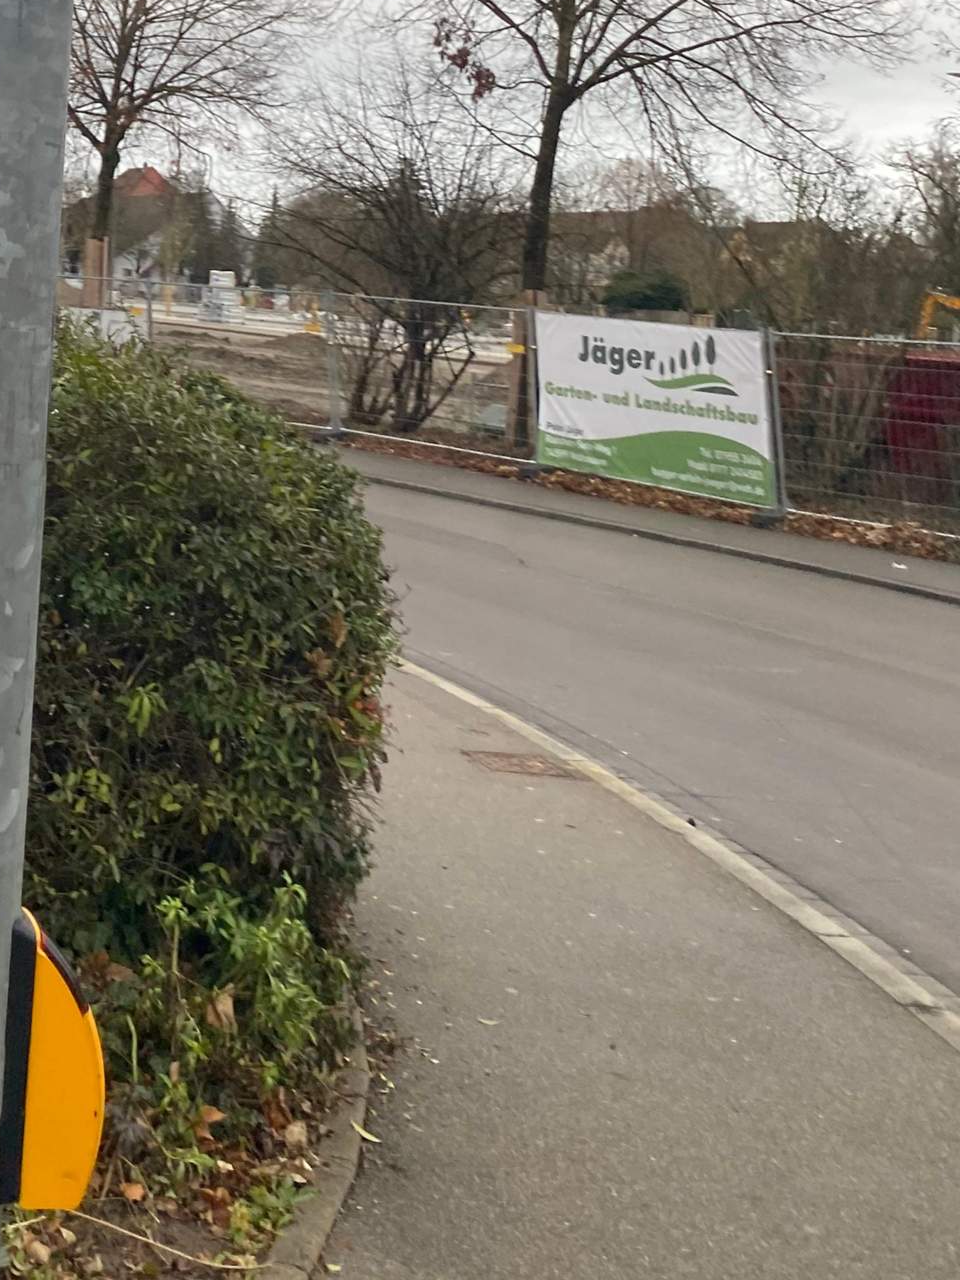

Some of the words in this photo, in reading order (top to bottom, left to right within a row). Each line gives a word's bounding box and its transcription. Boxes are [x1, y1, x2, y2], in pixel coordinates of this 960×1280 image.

[578, 335, 655, 374] Jäger
[544, 381, 597, 402] Garten-
[602, 391, 630, 407] und
[635, 395, 759, 425] Landschaftsbau
